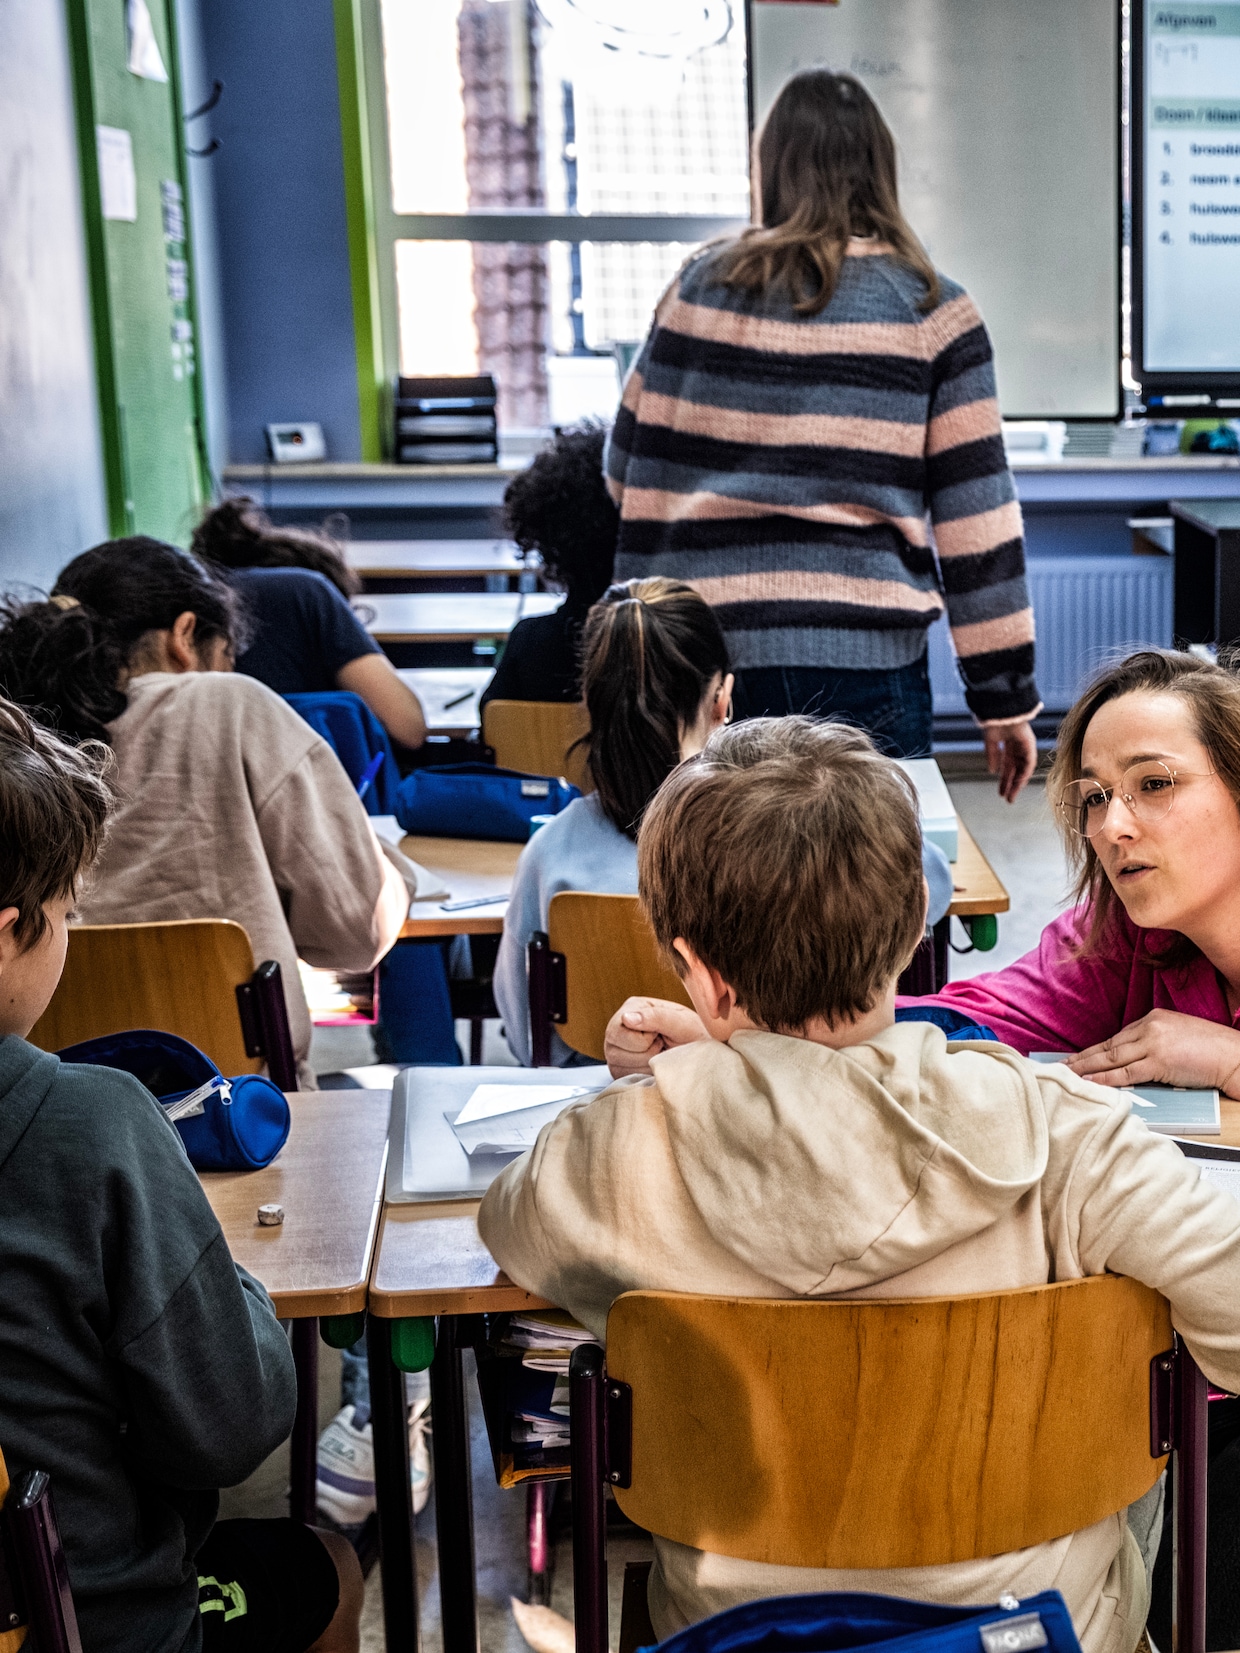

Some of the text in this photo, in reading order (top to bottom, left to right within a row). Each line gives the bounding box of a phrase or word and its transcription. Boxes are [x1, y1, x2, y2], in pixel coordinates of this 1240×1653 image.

[1155, 12, 1216, 31] Afgeven
[1155, 106, 1194, 121] Doen
[1161, 142, 1174, 155] 1.
[1159, 172, 1174, 186] 2.
[1190, 175, 1230, 186] neem
[1159, 201, 1174, 215] 3.
[1159, 230, 1174, 244] 4.
